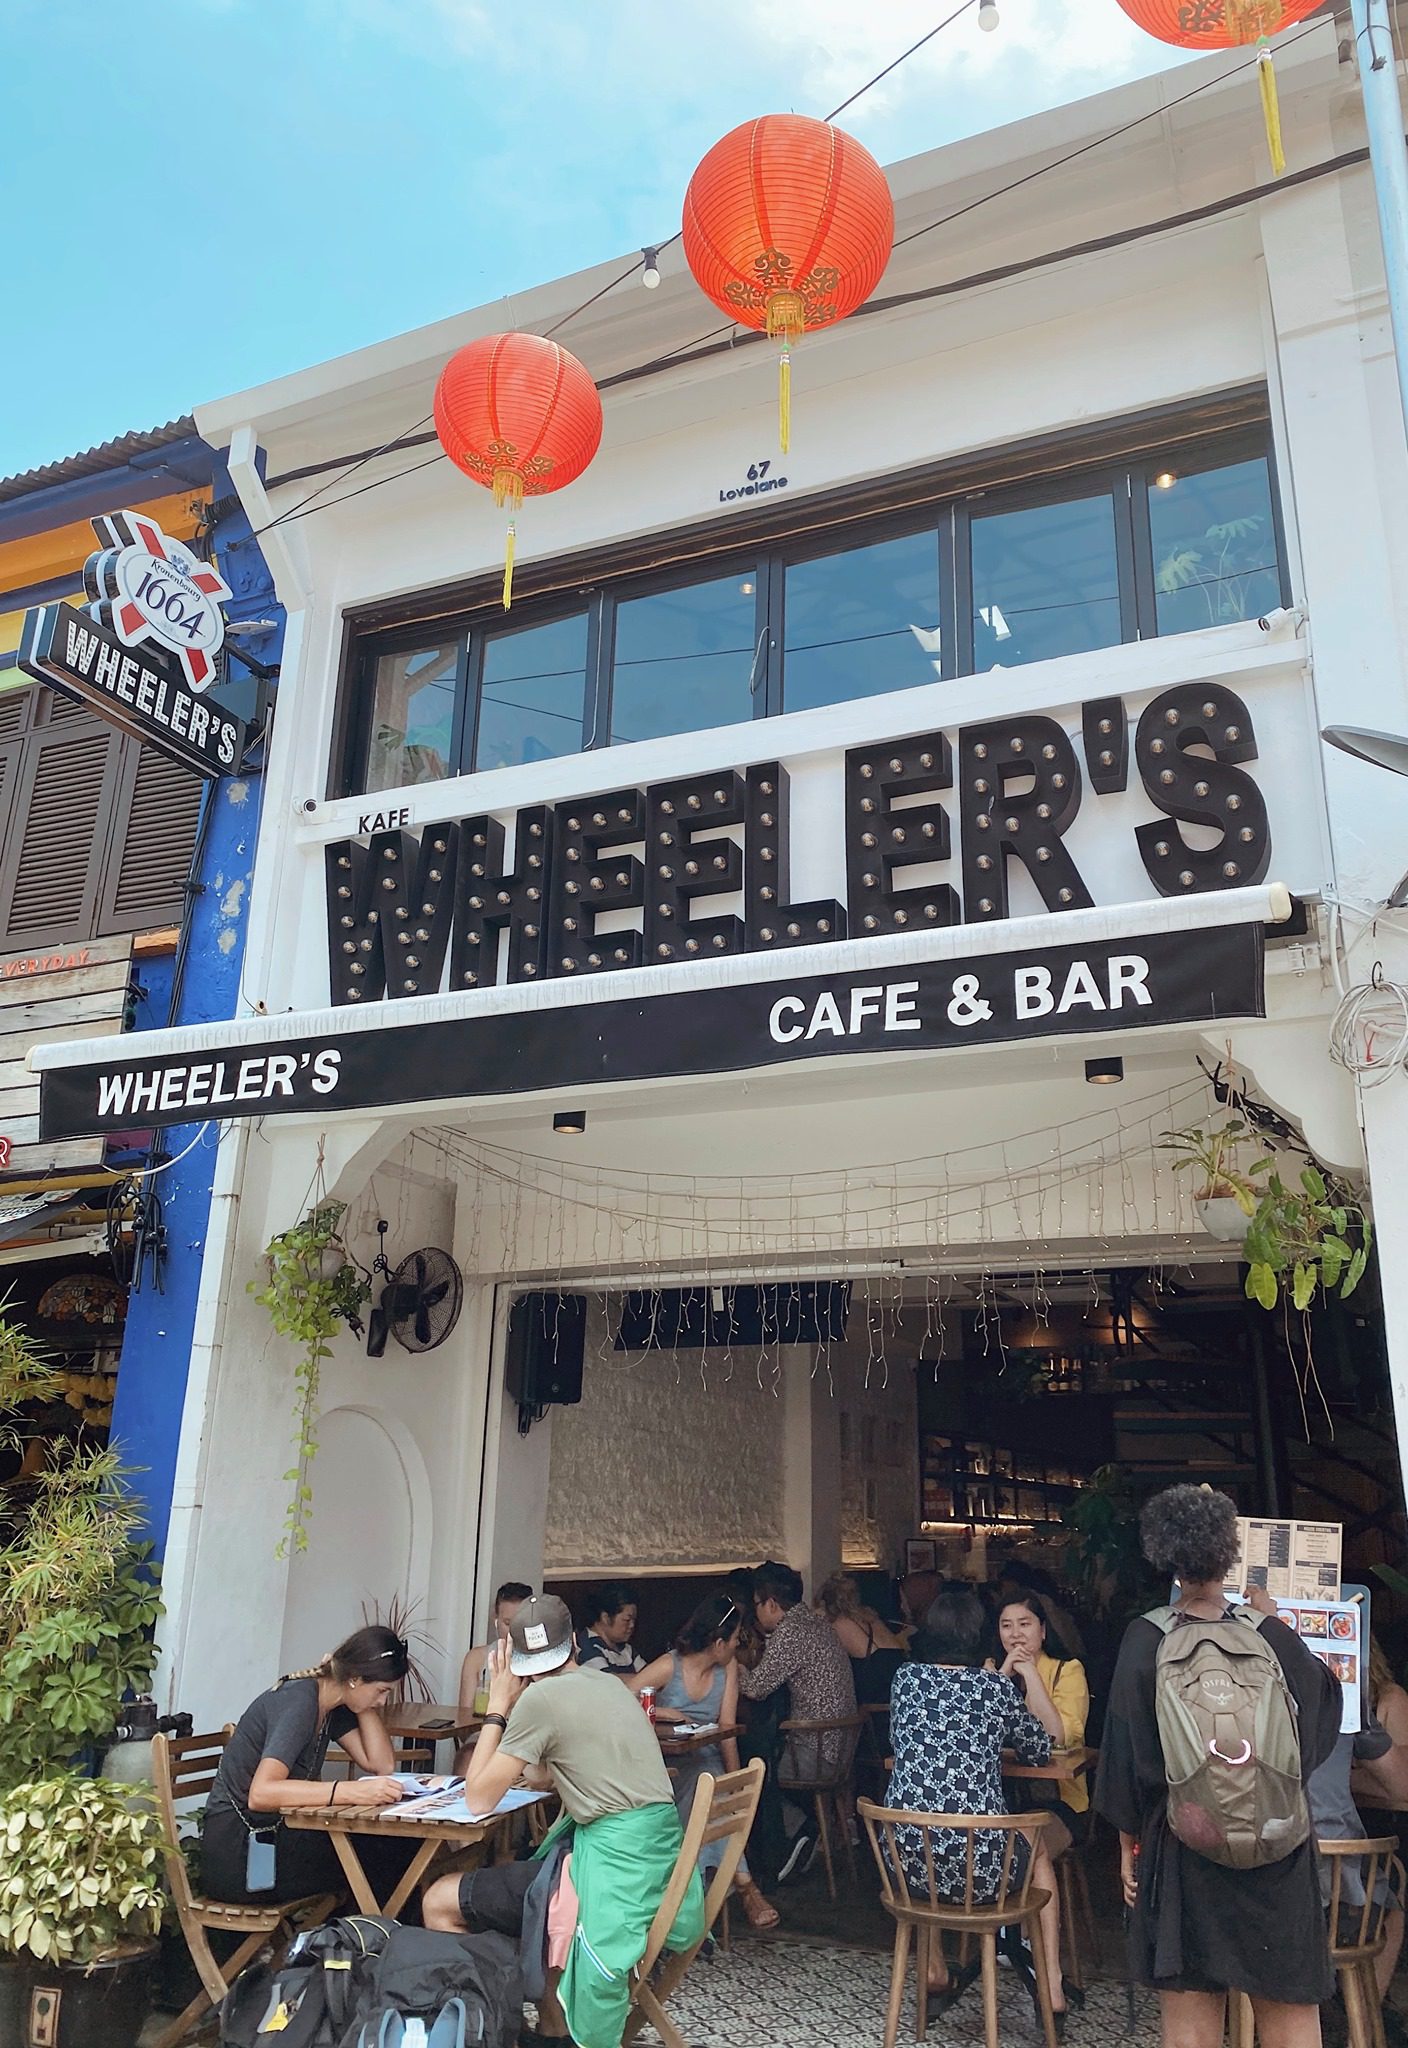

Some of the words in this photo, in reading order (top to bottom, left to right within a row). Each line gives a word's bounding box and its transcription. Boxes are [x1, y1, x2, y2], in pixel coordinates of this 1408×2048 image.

[719, 477, 788, 502] Lovelane
[747, 460, 771, 481] 67
[151, 559, 201, 602] Kronenbourg
[134, 570, 206, 639] 1664
[64, 619, 238, 765] WHEELER'S
[324, 681, 1272, 1003] WHEELER'S
[358, 807, 409, 834] KAFE
[0, 947, 89, 977] VERYDAY
[97, 1049, 342, 1117] WHEELER'S
[768, 980, 922, 1044] CAFE
[946, 973, 994, 1027] &
[1014, 954, 1153, 1020] BAR
